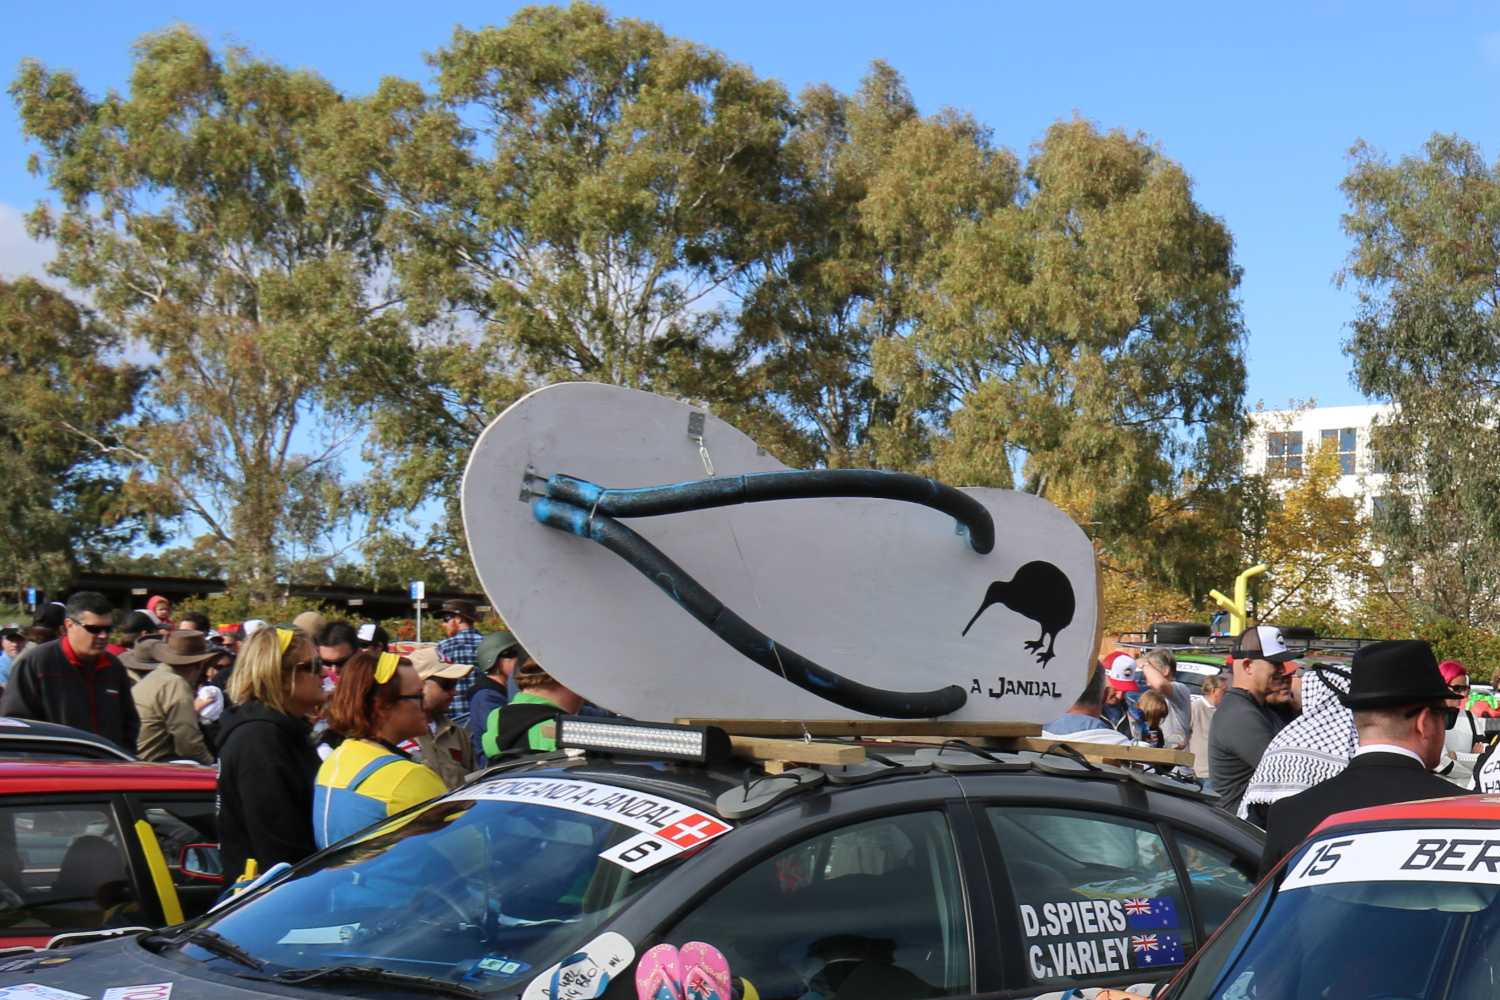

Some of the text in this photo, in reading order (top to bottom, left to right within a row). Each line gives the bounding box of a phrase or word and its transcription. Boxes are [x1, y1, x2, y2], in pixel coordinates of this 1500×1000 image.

[970, 677, 1062, 699] A JANDAL
[582, 791, 680, 828] JANDAL
[1299, 839, 1354, 879] 15
[1019, 899, 1127, 937] D.SPIERS
[1029, 937, 1130, 979] C.VARLEY
